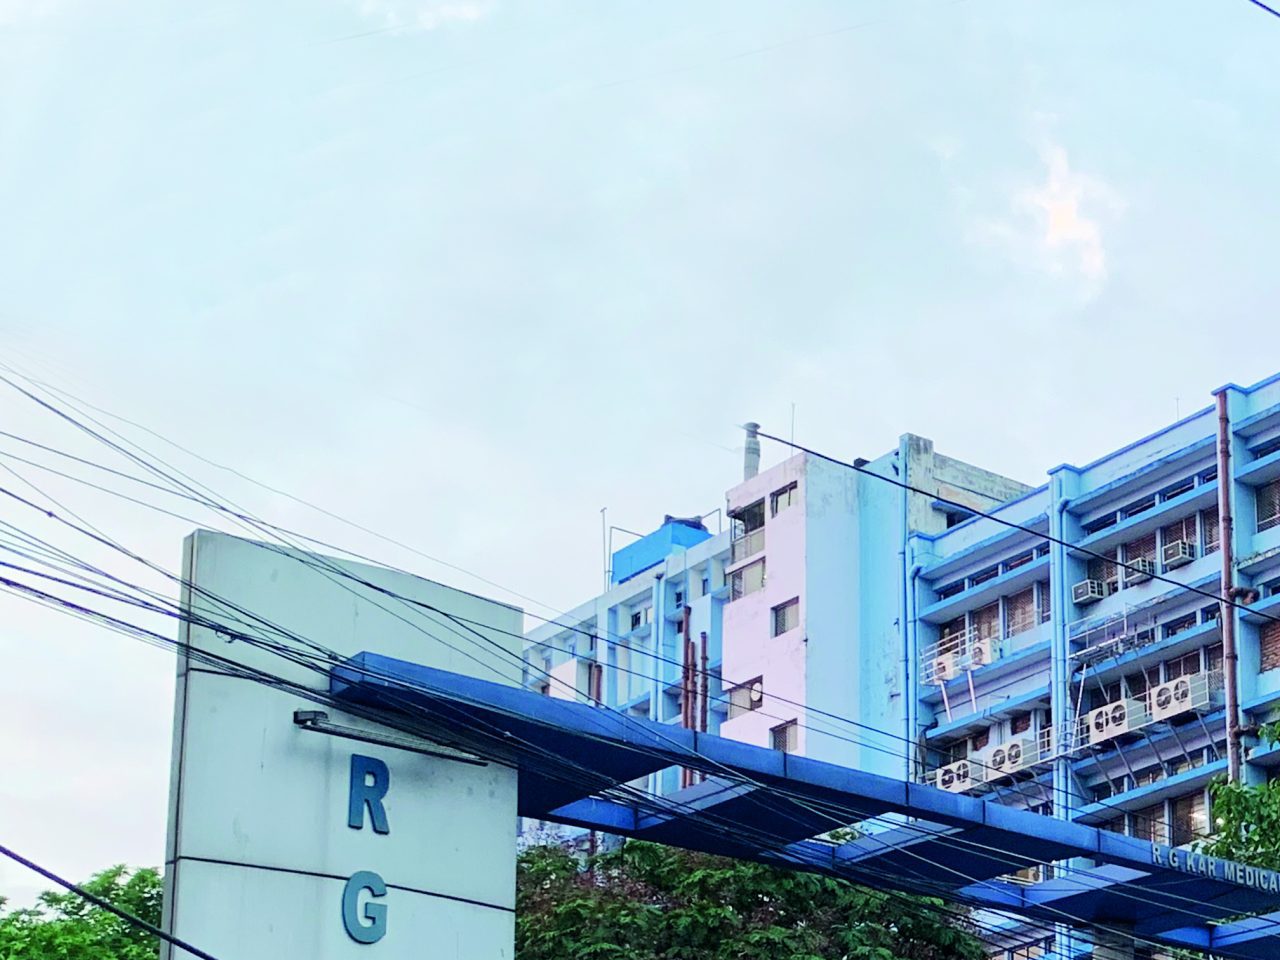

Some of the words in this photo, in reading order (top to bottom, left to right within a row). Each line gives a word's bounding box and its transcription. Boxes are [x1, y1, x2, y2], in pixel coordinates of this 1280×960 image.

[348, 753, 390, 834] R
[1186, 852, 1216, 877] KAR
[342, 870, 388, 944] G
